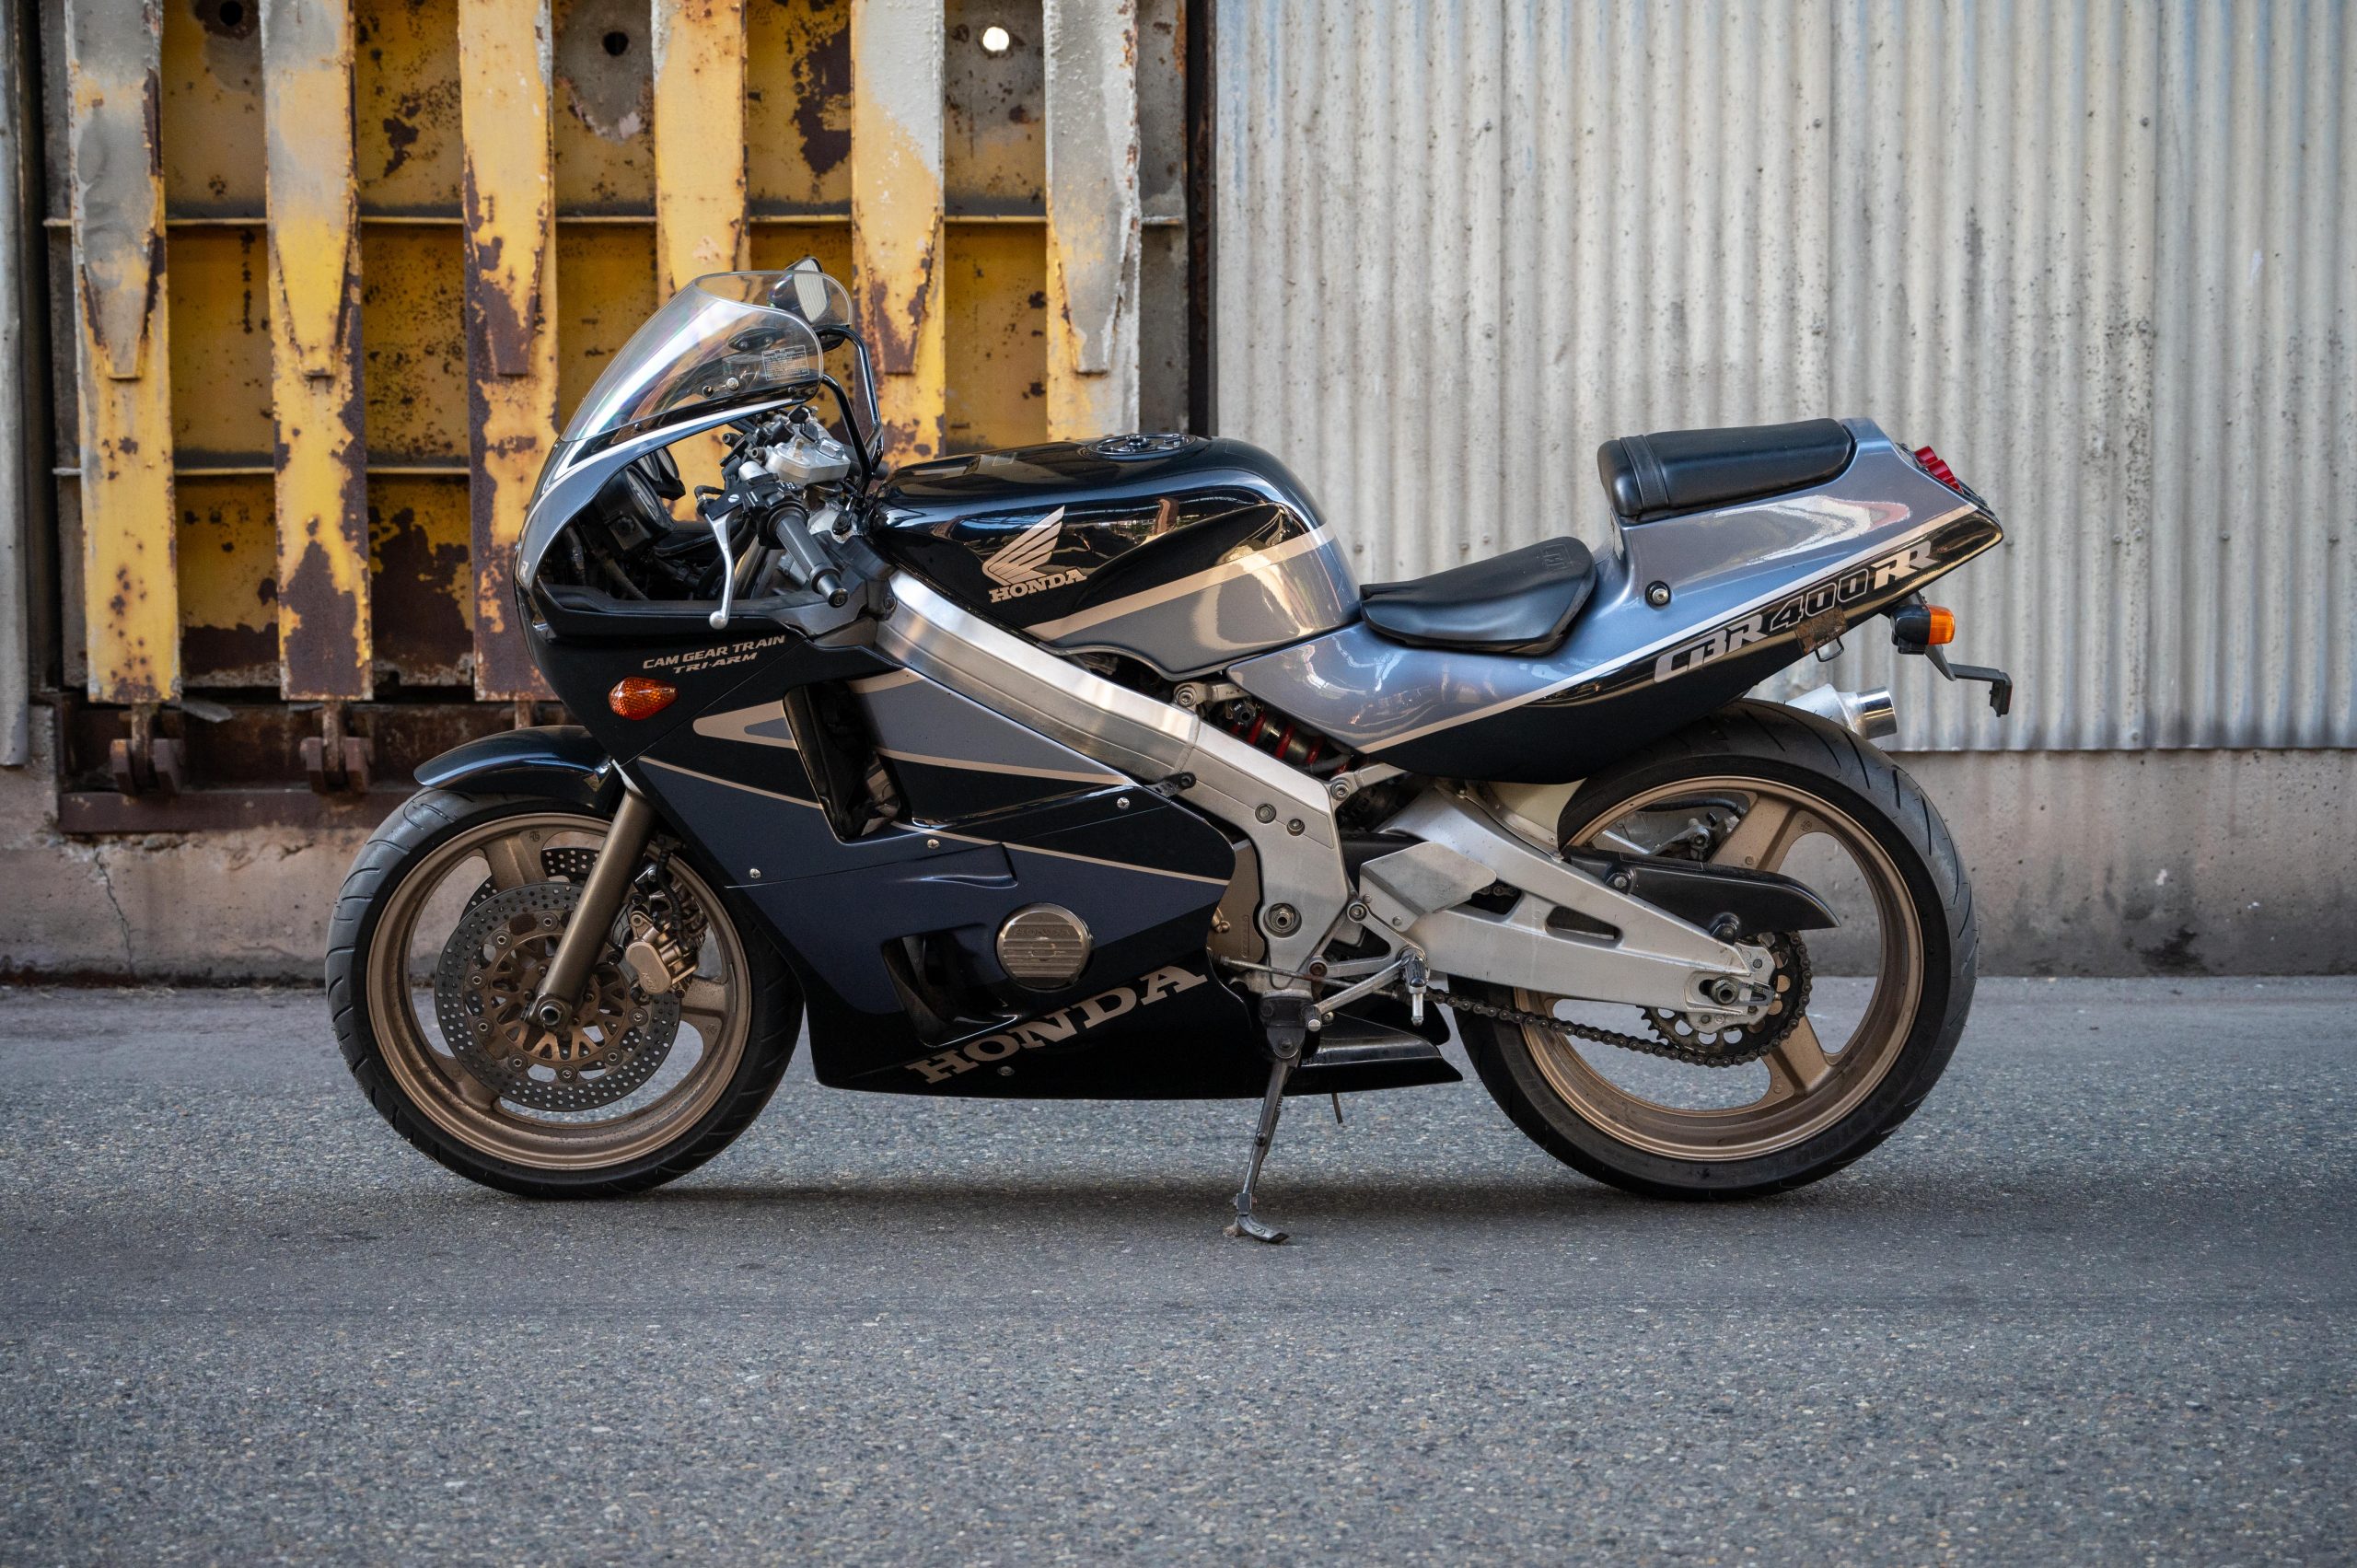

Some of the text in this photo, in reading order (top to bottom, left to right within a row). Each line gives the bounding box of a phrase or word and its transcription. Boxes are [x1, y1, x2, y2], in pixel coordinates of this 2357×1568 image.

[988, 568, 1087, 604] HONDA
[643, 634, 785, 669] CAM GEAR TRAIN
[904, 966, 1208, 1084] HONDA
